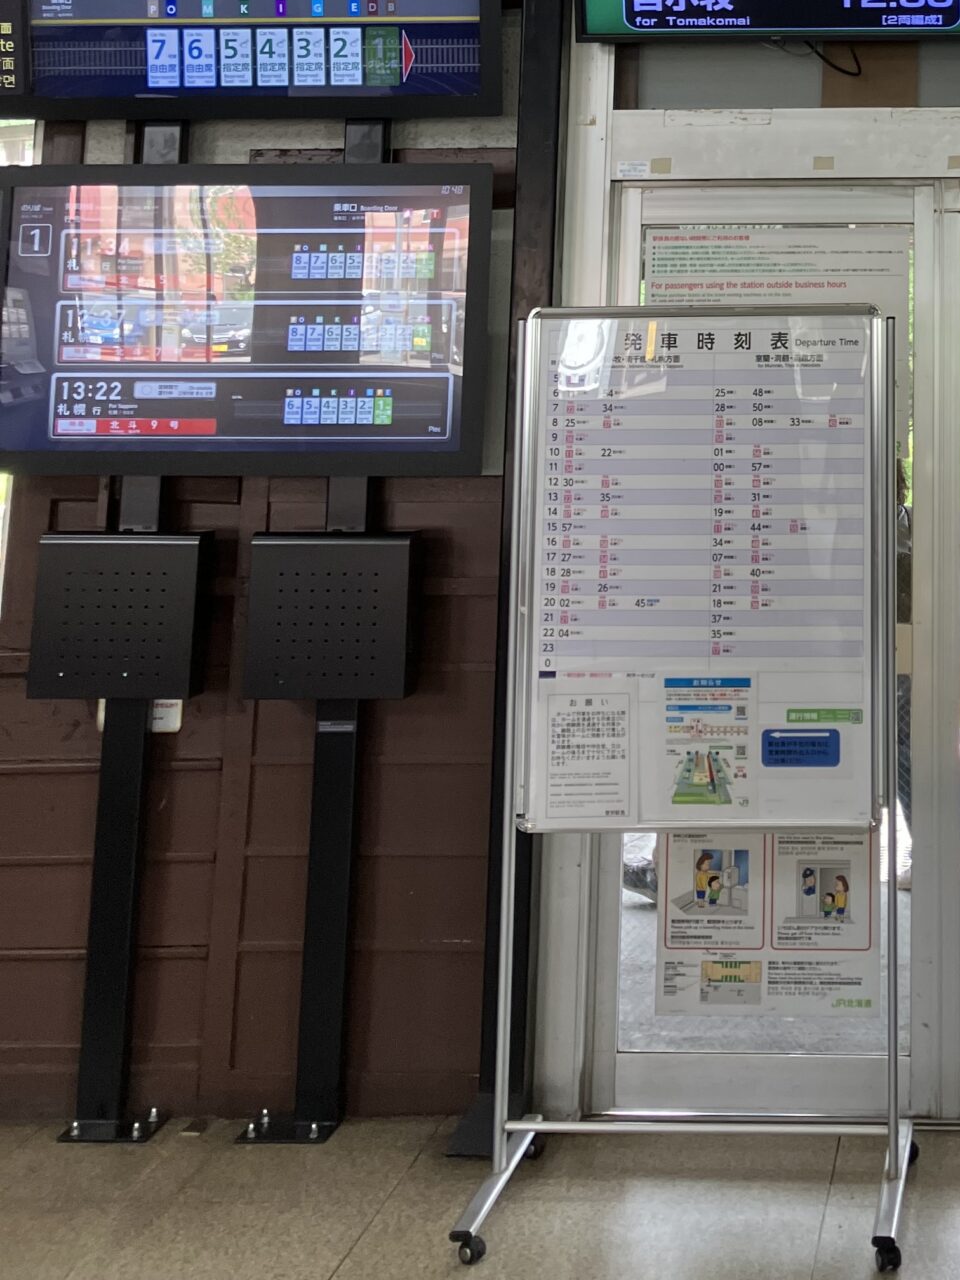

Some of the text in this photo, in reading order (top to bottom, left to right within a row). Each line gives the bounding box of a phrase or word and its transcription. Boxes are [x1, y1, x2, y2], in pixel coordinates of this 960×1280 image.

[636, 16, 750, 25] for Tomakomai
[151, 40, 166, 59] 7
[188, 39, 202, 59] 6
[224, 39, 237, 59] 5
[260, 38, 275, 58] 4
[297, 38, 310, 58] 3
[334, 38, 347, 58] 2
[30, 229, 40, 251] 1
[665, 282, 703, 291] passengers
[706, 282, 724, 290] using
[795, 339, 836, 347] Departure
[62, 382, 122, 400] 13:22
[602, 404, 612, 412] 34
[753, 403, 763, 411] 50
[565, 418, 800, 427] 25 08 33
[550, 448, 560, 456] 10
[714, 448, 723, 456] 01
[544, 598, 645, 607] 20 02 45
